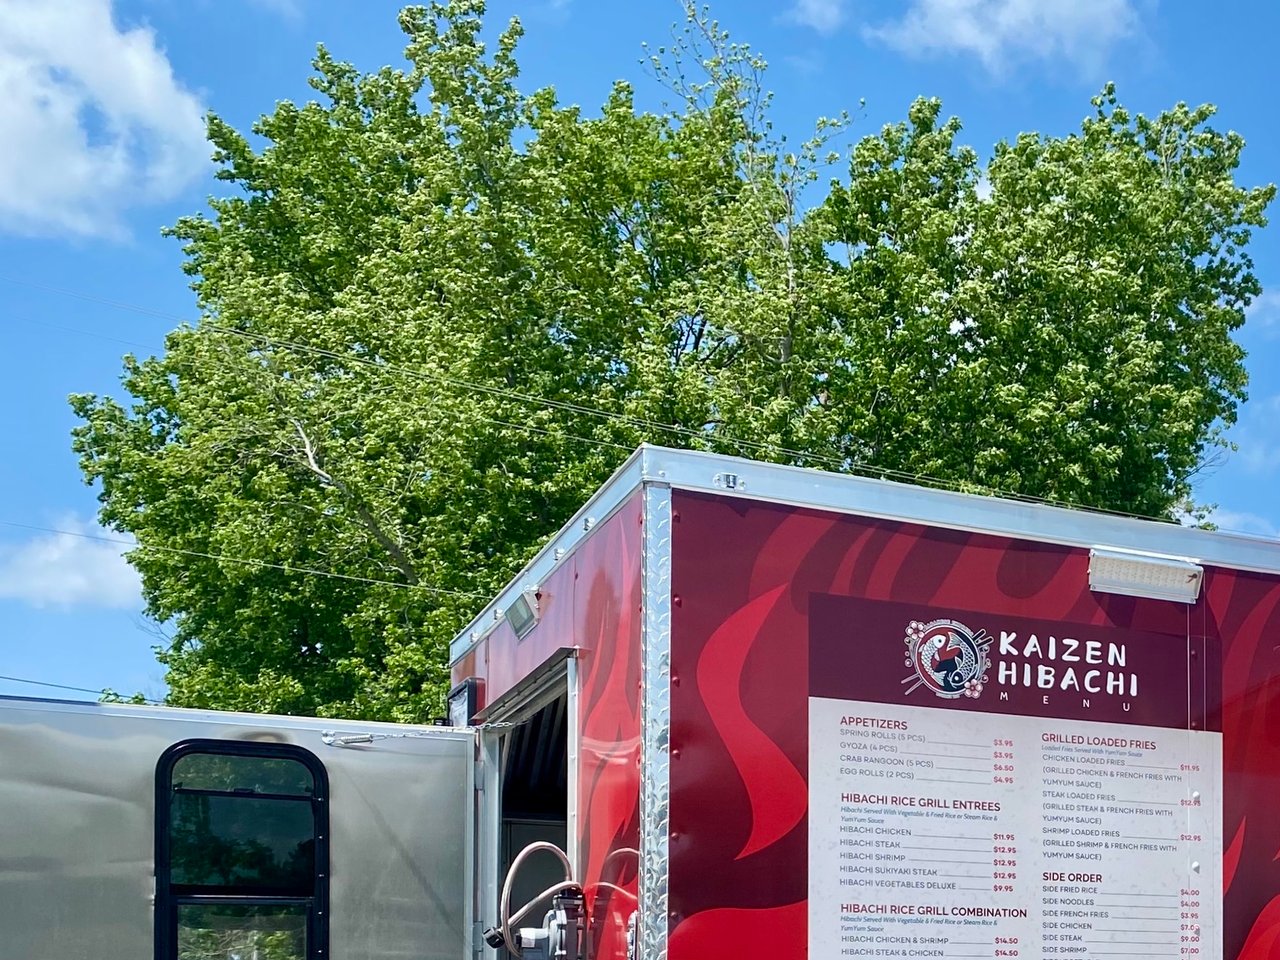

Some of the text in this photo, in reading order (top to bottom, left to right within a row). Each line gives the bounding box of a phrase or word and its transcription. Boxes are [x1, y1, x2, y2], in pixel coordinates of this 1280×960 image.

[1000, 631, 1126, 667] KAIZEN
[998, 661, 1138, 696] HIBACHI
[1000, 691, 1130, 711] MENU
[840, 716, 907, 730] APPETIZERS
[840, 729, 869, 738] SPRING
[870, 731, 896, 740] ROLLS
[840, 742, 868, 751] GYOZA
[1042, 733, 1156, 750] GRILLED LOADED FRIES
[840, 755, 862, 763] CRAB
[863, 756, 904, 766] RANGOON
[1042, 754, 1075, 763] CHICKEN
[1076, 756, 1105, 765] LOADED
[858, 769, 884, 777] ROLLS
[842, 794, 1000, 811] HIBACHI RICE GRILL ENTREES
[840, 826, 873, 834] HIBACHI
[874, 828, 913, 836] CHICKEN
[840, 839, 873, 847] HIBACHI
[874, 840, 902, 848] STEAK
[1043, 872, 1102, 882] SIDE ORDER
[841, 905, 1027, 918] HIBACHI RICE GRILL COMBINATION
